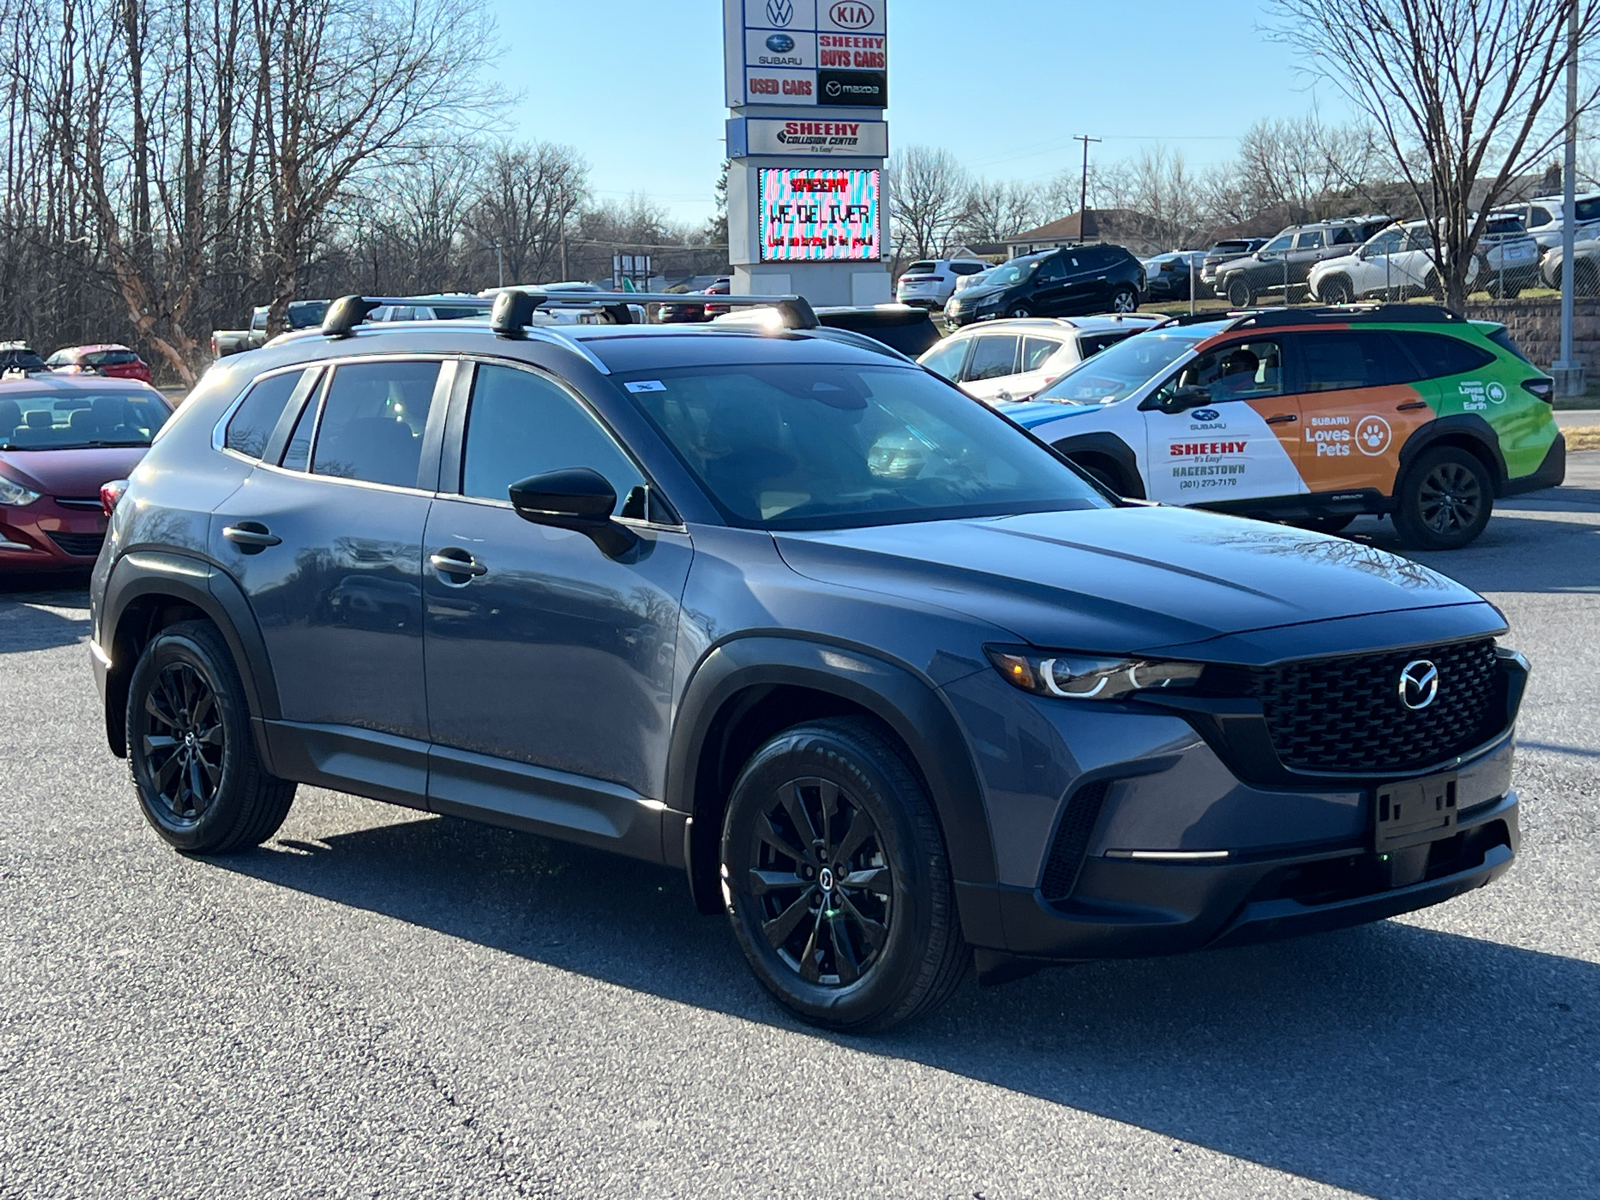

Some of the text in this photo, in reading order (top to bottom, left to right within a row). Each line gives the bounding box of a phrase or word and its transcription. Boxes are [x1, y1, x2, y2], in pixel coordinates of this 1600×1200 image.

[838, 7, 867, 23] KIA
[819, 35, 885, 48] SHEEHY
[759, 56, 802, 66] SUBARU
[820, 50, 884, 68] BUYS CARS
[750, 78, 812, 96] USED CARS
[785, 122, 860, 136] SHEEHY
[786, 136, 858, 145] COLLISION CENTER
[770, 205, 869, 223] WE DELIVER
[1311, 416, 1349, 426] SUBARU
[1305, 427, 1350, 442] Loves
[1170, 441, 1248, 456] SHEEHY
[1317, 442, 1350, 457] Pets
[1172, 464, 1245, 477] HAGERSTOWN
[1180, 480, 1200, 490] (301)
